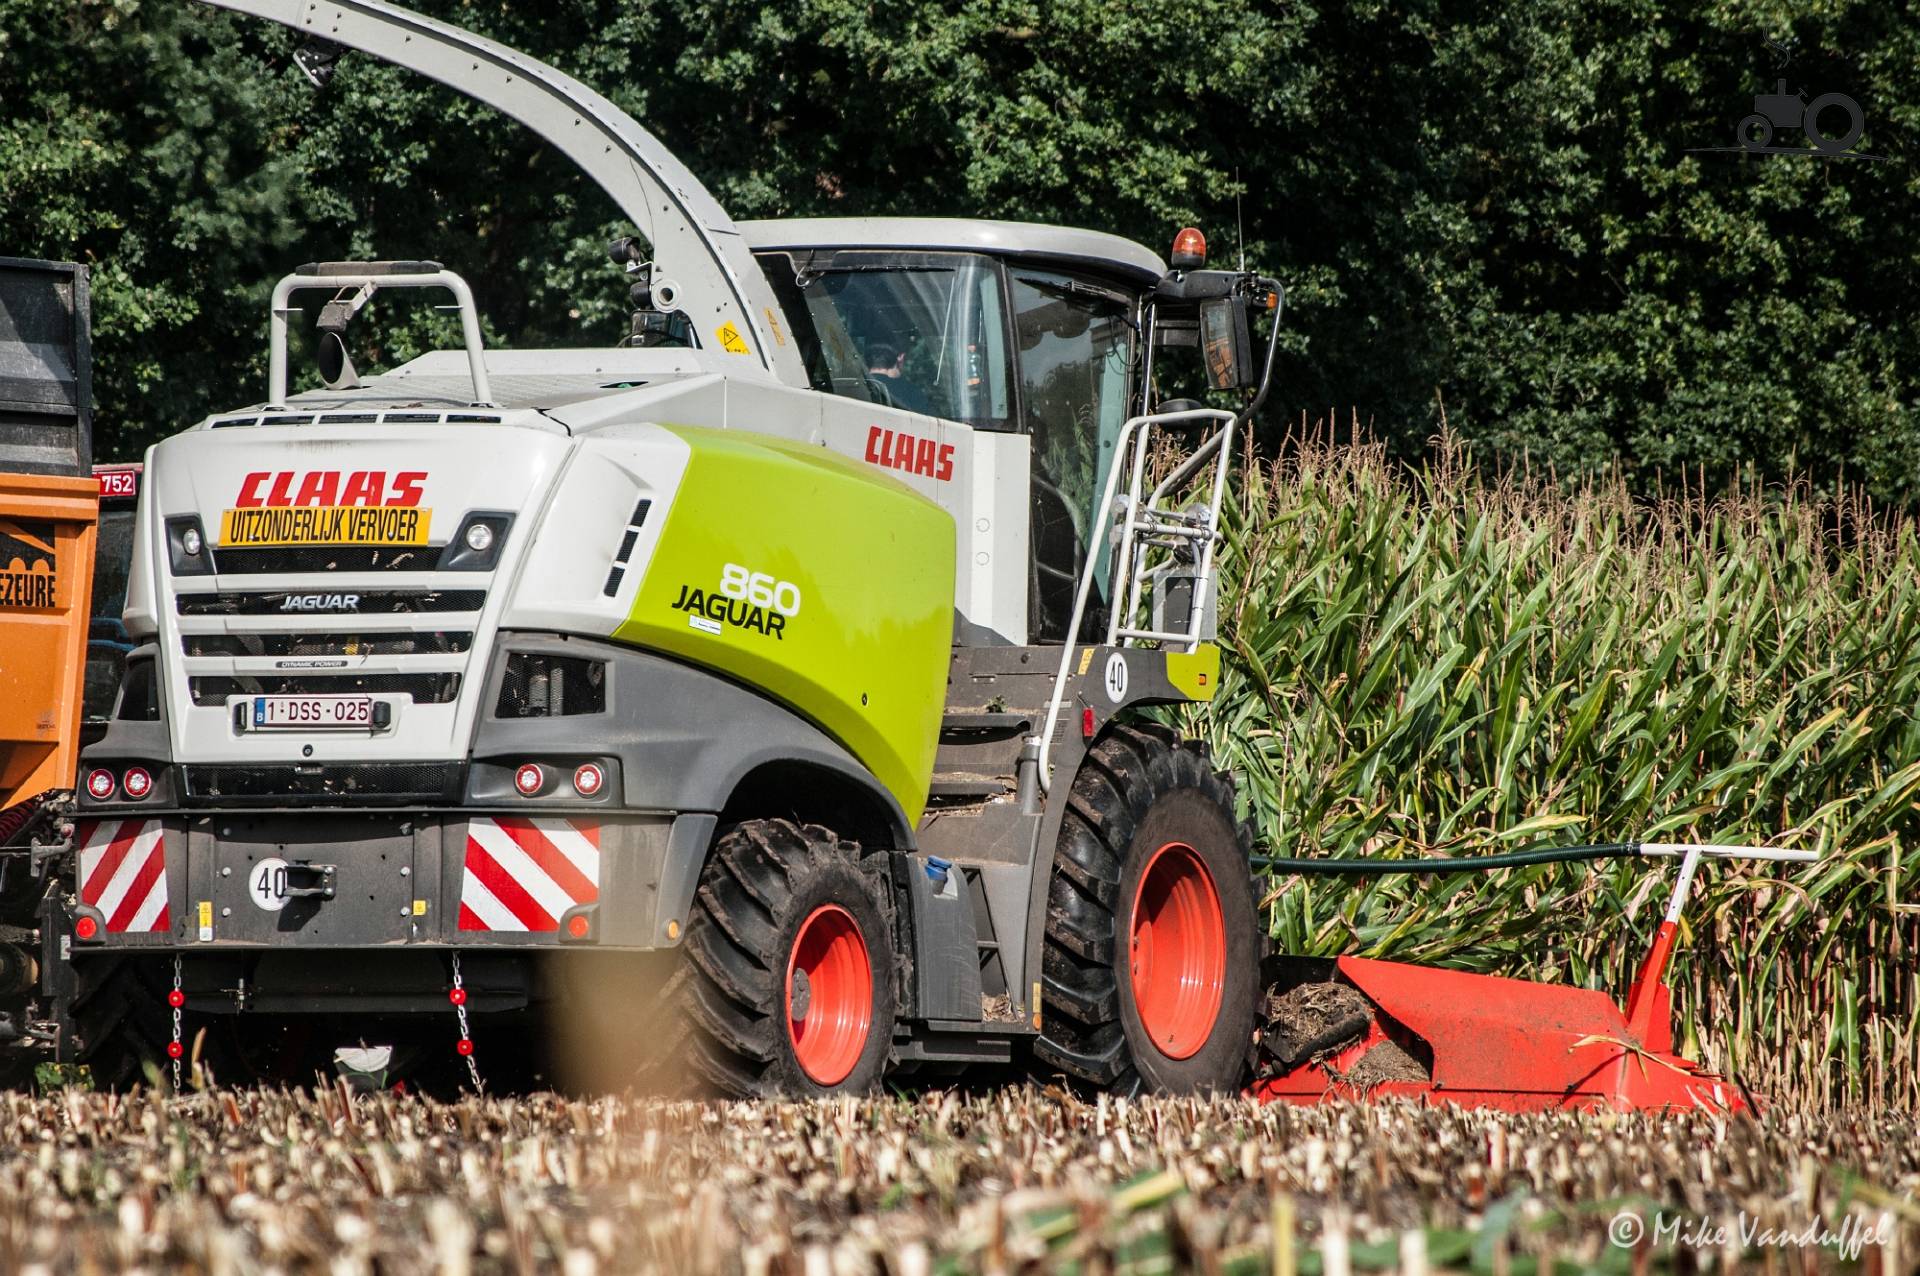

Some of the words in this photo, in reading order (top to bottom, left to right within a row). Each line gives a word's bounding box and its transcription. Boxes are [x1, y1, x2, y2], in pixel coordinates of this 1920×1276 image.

[865, 426, 955, 481] CLAAS
[102, 475, 133, 493] 752
[235, 471, 429, 508] CLAAS
[230, 508, 346, 543] UITZONDERLIJK
[349, 508, 419, 541] VERVOER
[280, 594, 360, 610] JAGUAR
[720, 563, 801, 617] 860
[671, 585, 786, 640] JAGUAR
[1110, 661, 1123, 692] 40
[256, 712, 264, 722] B
[257, 867, 286, 899] 40
